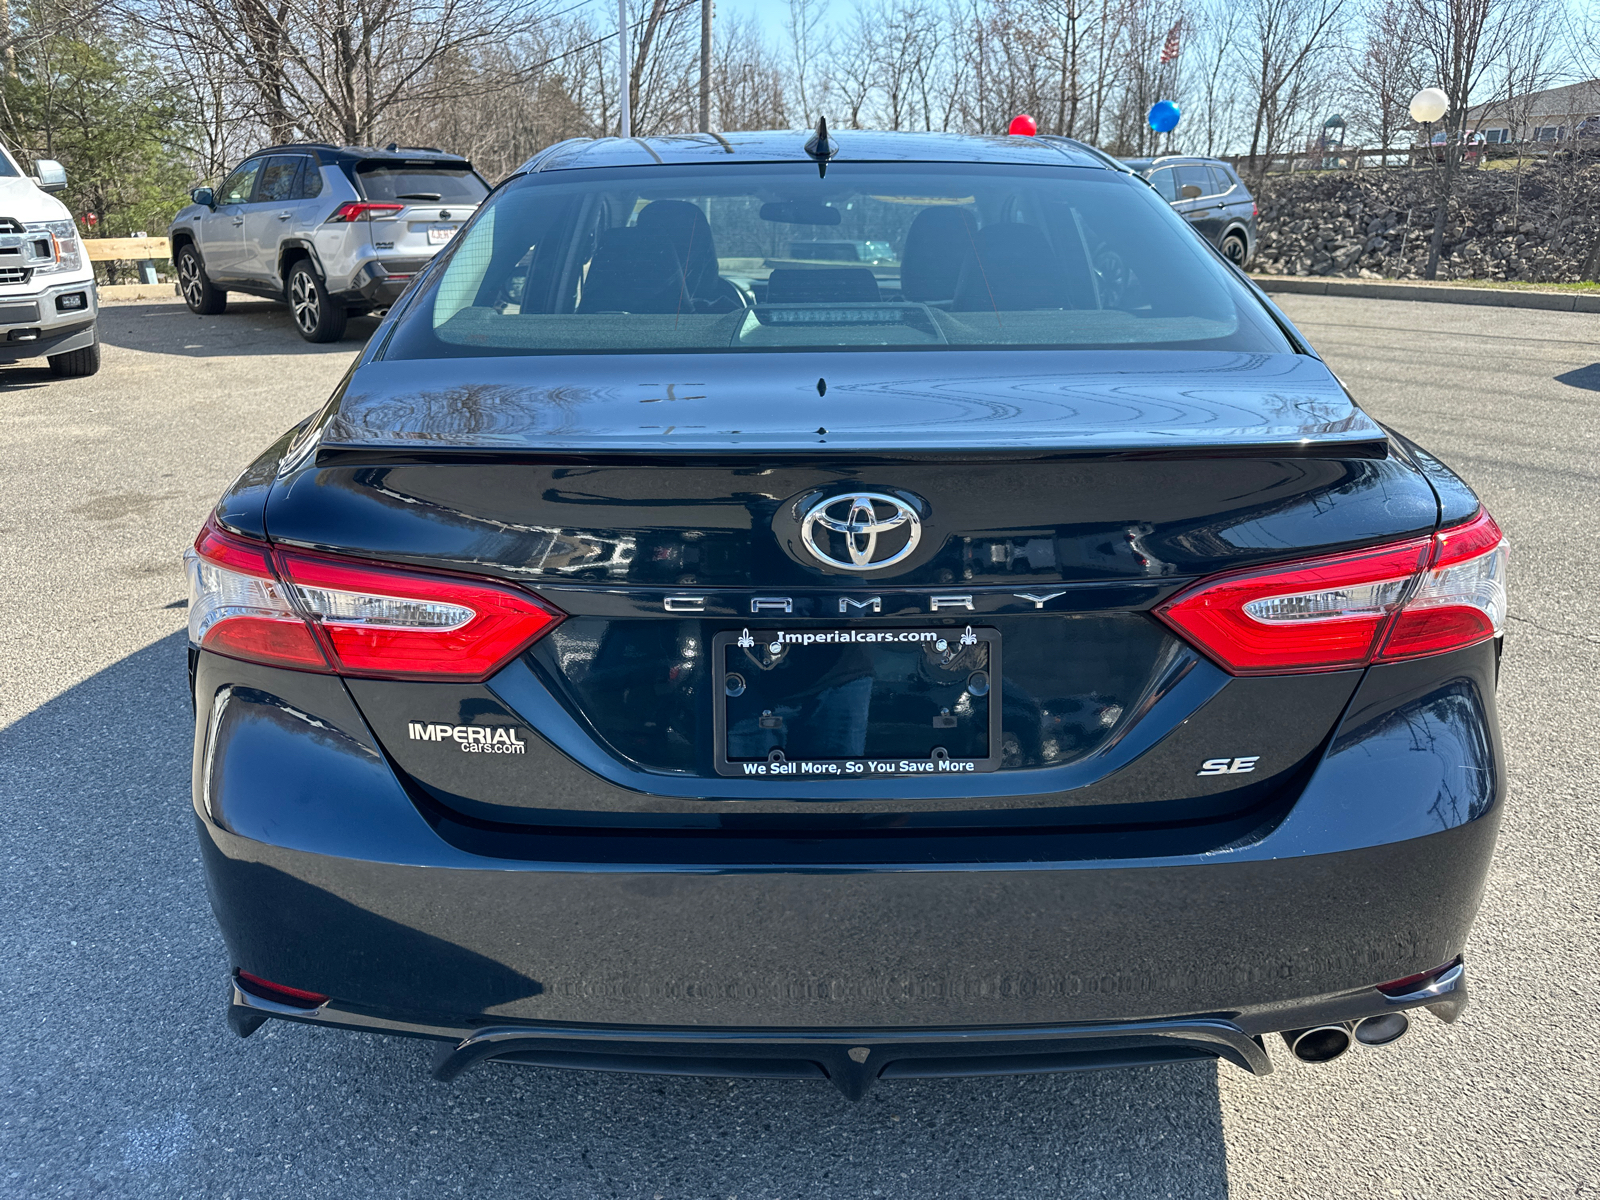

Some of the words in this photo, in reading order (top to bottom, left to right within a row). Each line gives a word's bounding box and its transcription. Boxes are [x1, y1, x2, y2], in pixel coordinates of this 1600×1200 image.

[664, 592, 1066, 613] CAMRY
[777, 630, 938, 646] Imperialcars.com
[408, 722, 525, 745] IMPERIAL
[461, 742, 525, 754] cars.com
[743, 763, 767, 774] We
[770, 762, 797, 774] Sell
[801, 762, 842, 775] More,
[845, 761, 864, 773] So
[868, 761, 896, 772] You
[899, 760, 935, 772] Save
[938, 760, 975, 771] More
[1196, 756, 1260, 776] SE
